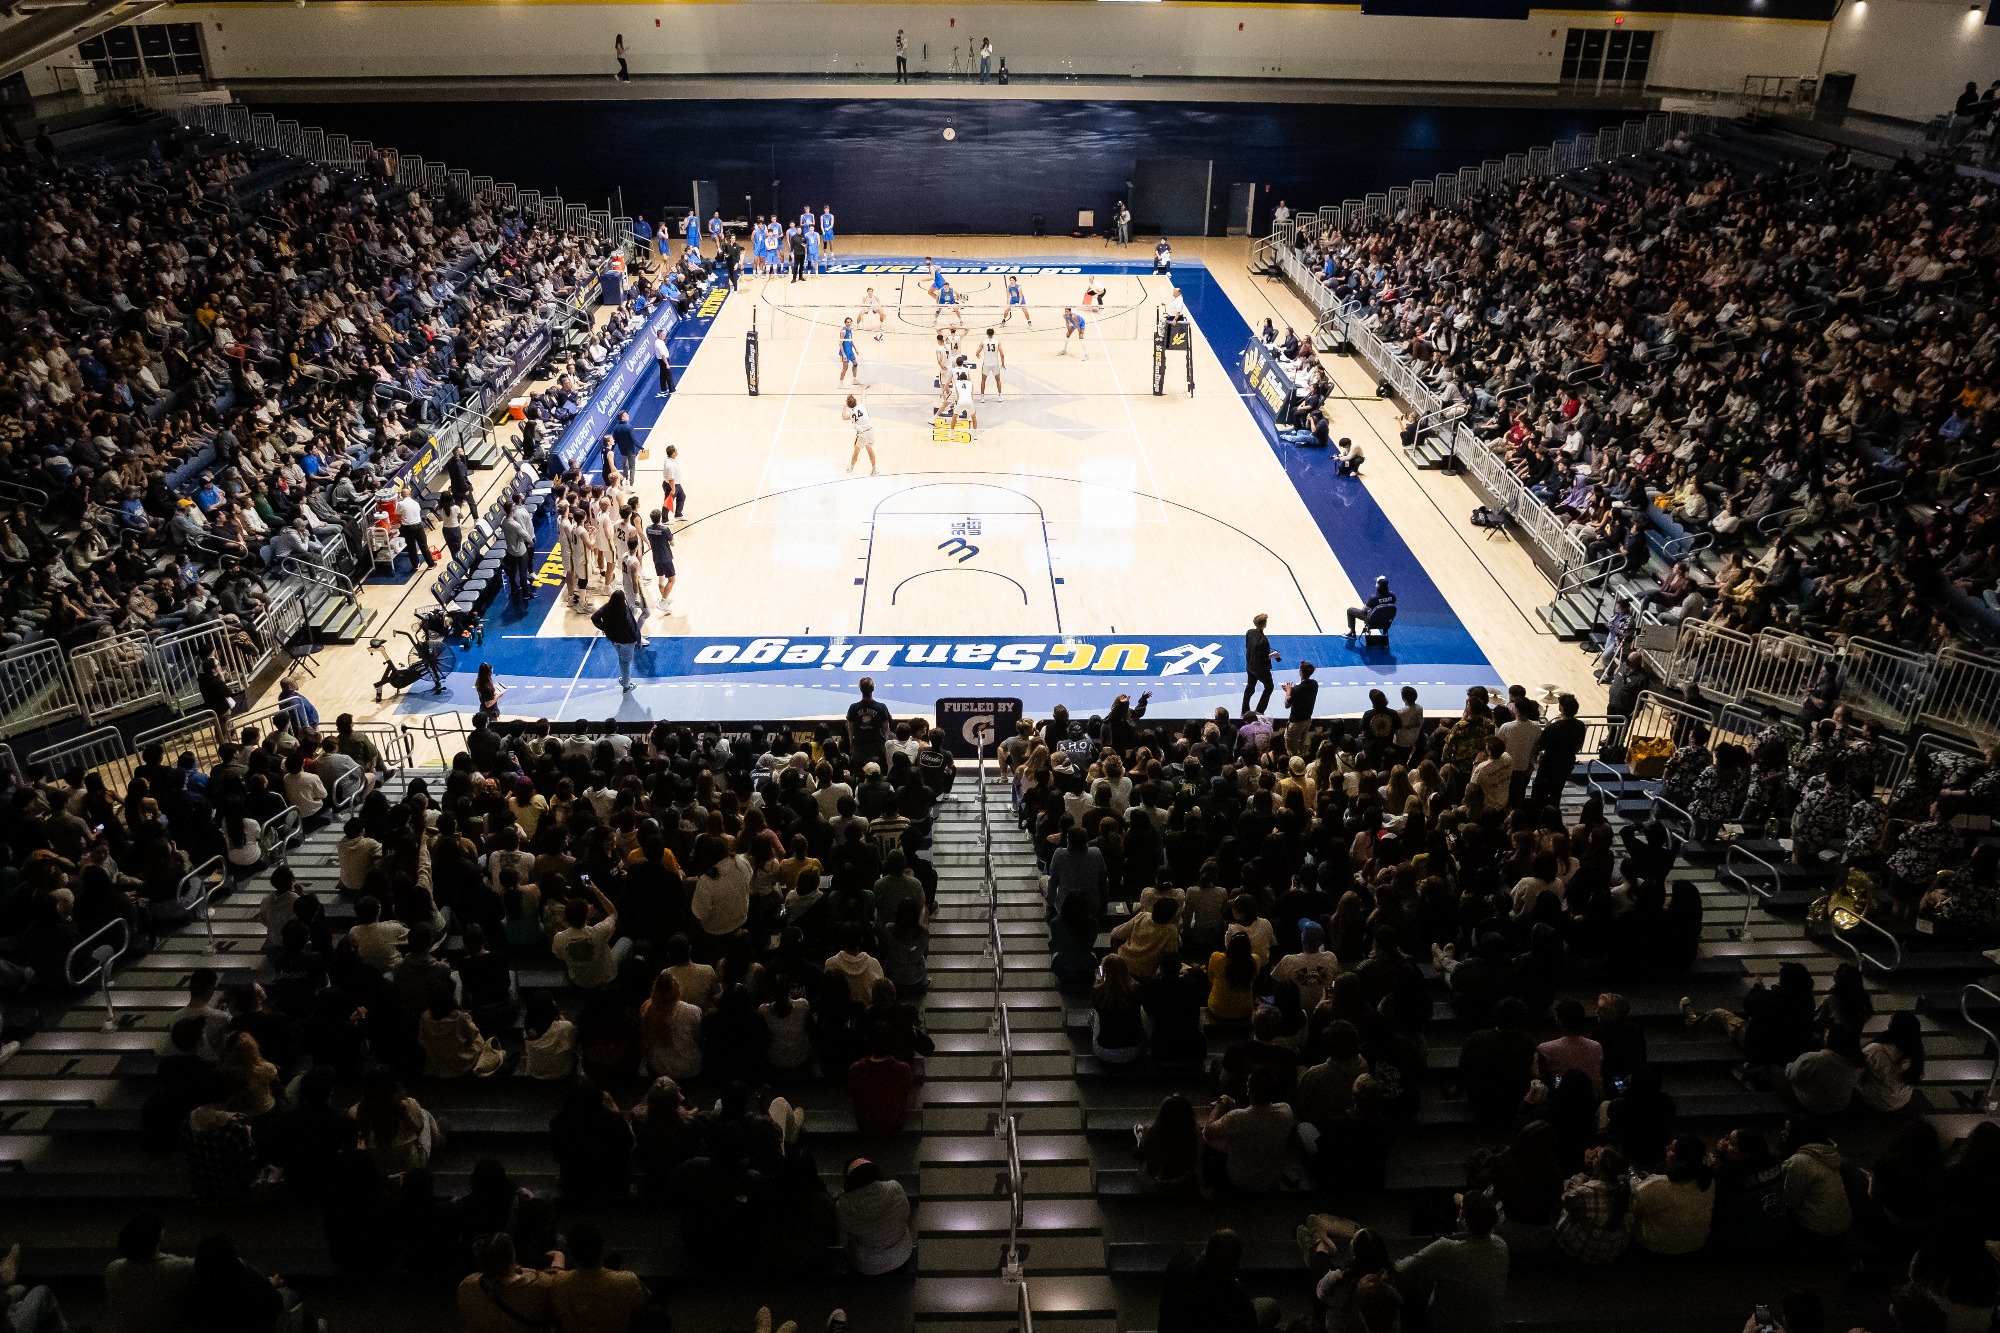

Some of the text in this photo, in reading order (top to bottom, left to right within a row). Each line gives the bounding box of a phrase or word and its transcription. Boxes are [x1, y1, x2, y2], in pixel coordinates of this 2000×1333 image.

[625, 337, 650, 373] UNIVERSITY
[986, 343, 996, 352] 13
[596, 373, 625, 415] UNIVERSITY
[851, 410, 863, 423] 24
[561, 416, 595, 461] UNIVERSITY
[617, 527, 626, 542] 23
[944, 702, 1015, 712] FUELED BY
